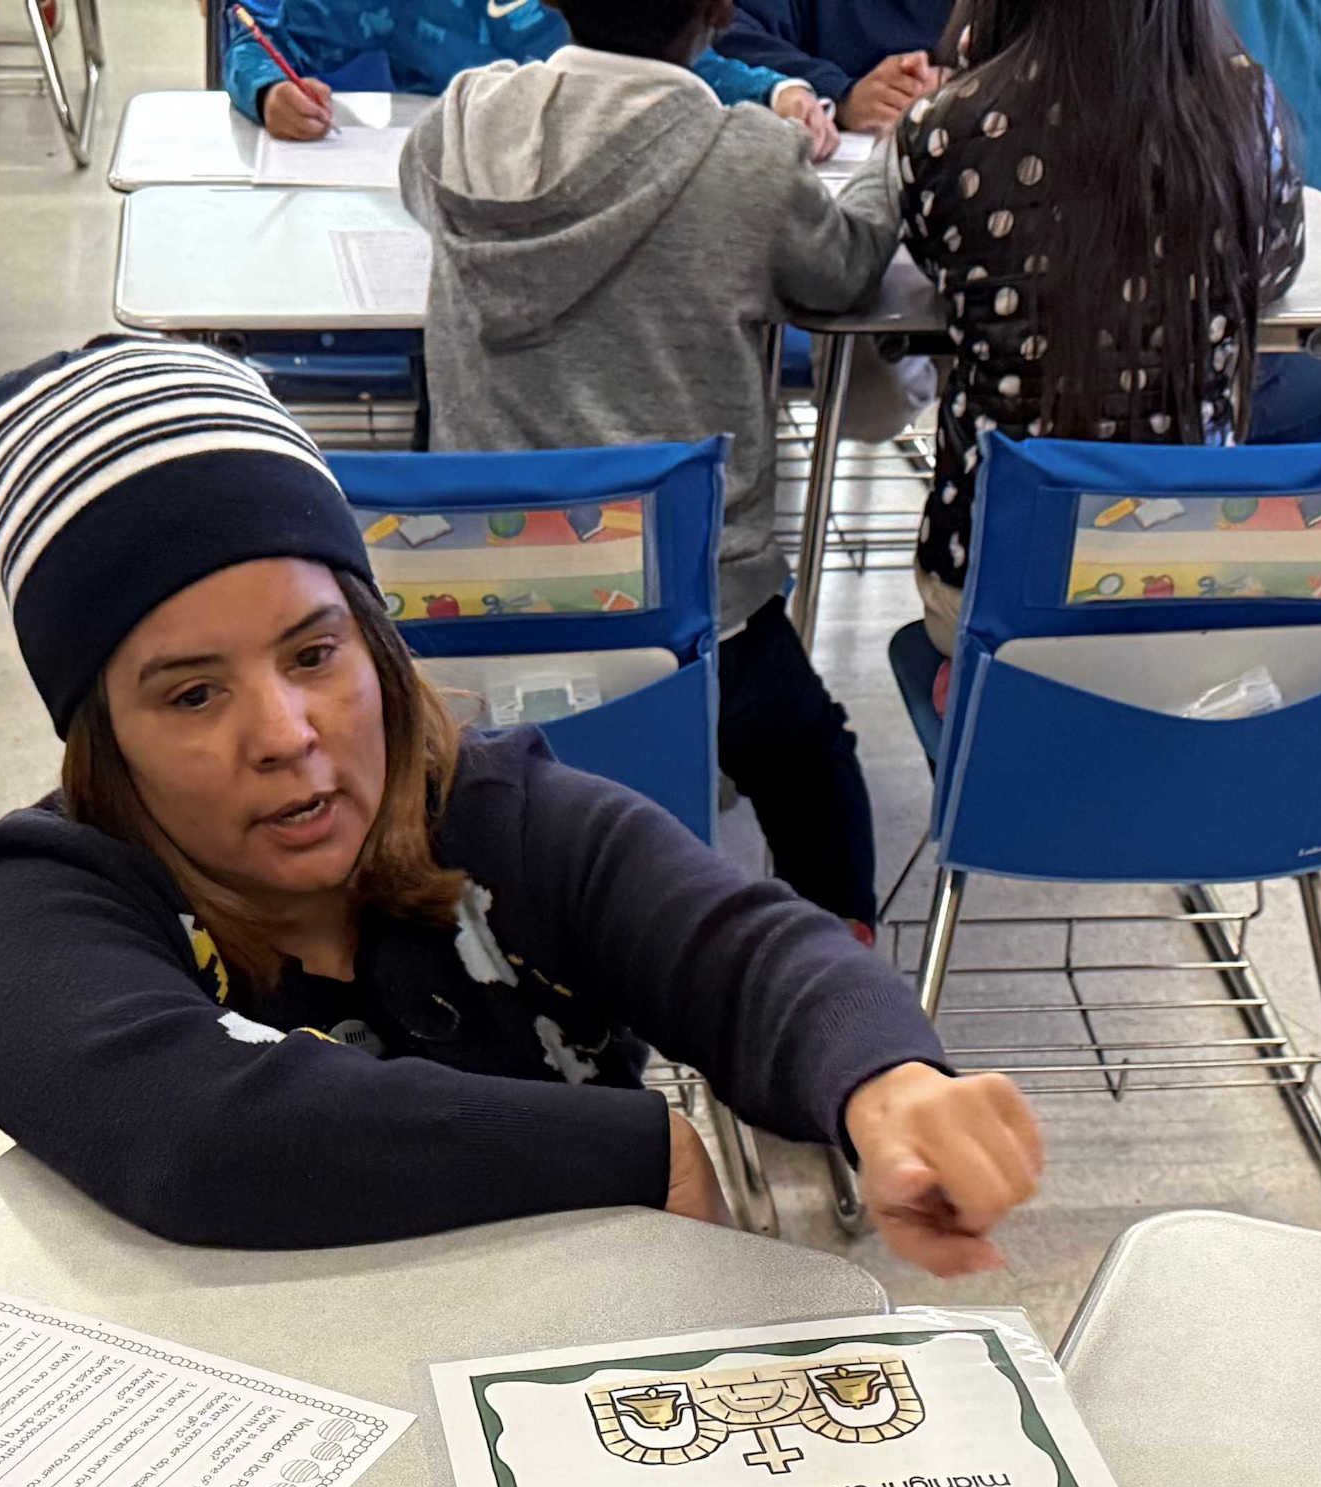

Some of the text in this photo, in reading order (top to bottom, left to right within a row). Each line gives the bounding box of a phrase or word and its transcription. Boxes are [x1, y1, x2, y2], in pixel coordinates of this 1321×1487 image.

[163, 1388, 190, 1407] What
[138, 1414, 160, 1427] the
[174, 1390, 228, 1438] receive gifts?
[208, 1402, 234, 1421] What
[208, 1404, 272, 1461] South America?
[255, 1413, 281, 1433] What
[108, 1426, 145, 1454] Spanish
[169, 1427, 202, 1458] another
[270, 1417, 315, 1452] Navidad
[232, 1440, 251, 1453] the
[86, 1453, 113, 1474] word
[149, 1457, 170, 1472] day
[209, 1452, 236, 1474] name
[242, 1463, 266, 1478] los
[73, 1473, 92, 1487] for
